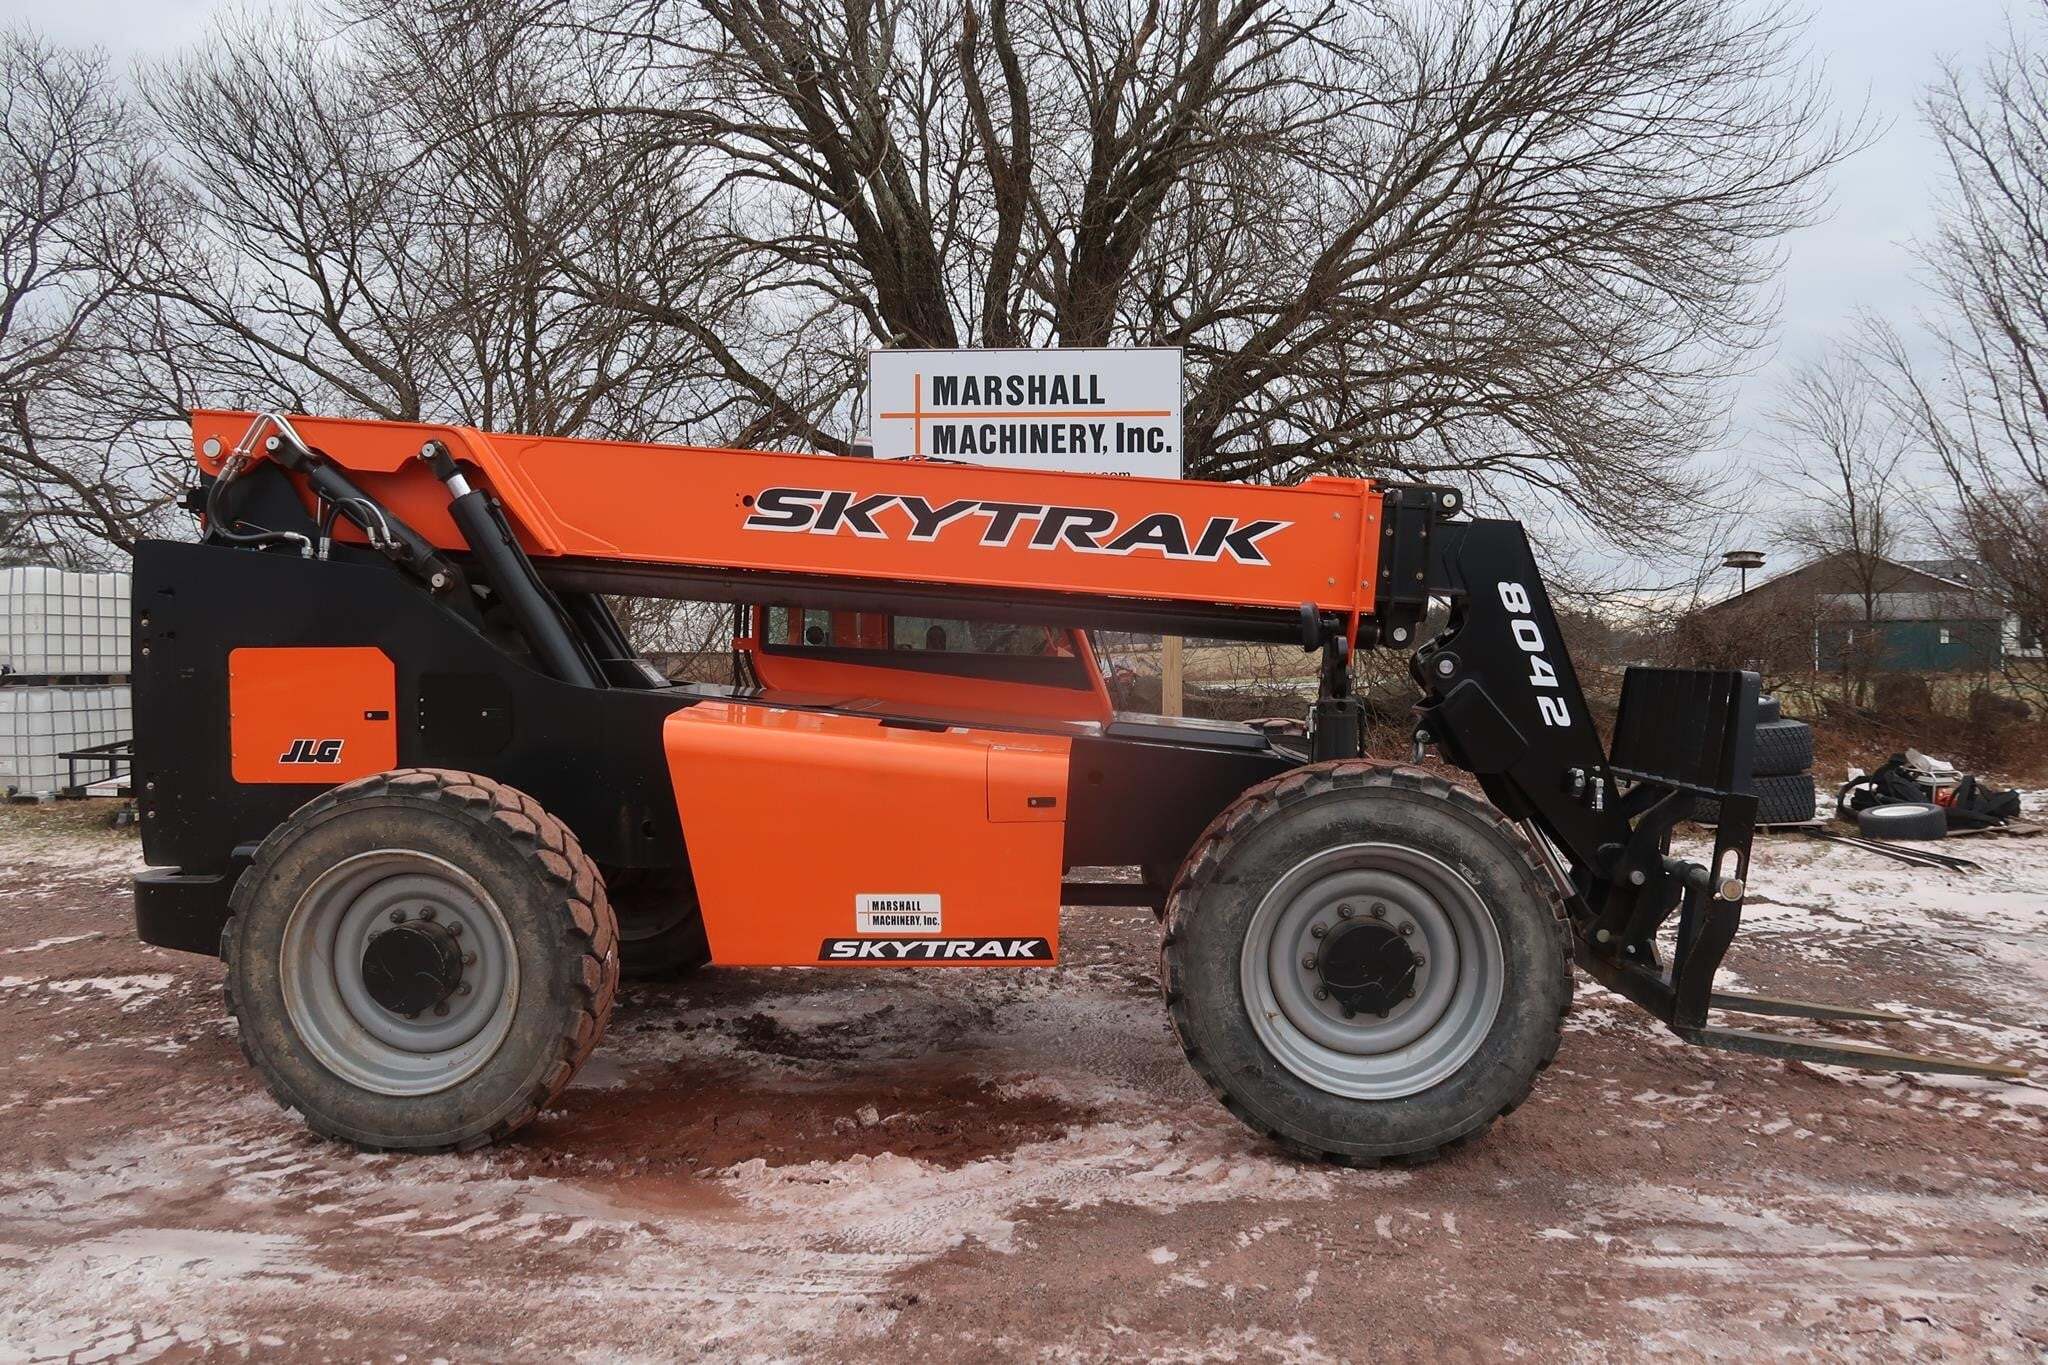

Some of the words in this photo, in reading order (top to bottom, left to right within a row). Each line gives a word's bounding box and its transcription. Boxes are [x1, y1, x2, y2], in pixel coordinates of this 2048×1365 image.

[932, 374, 1106, 406] MARSHALL
[932, 422, 1109, 456] MACHINERY,
[1115, 422, 1173, 453] Inc.
[743, 487, 1295, 567] SKYTRAK
[1497, 581, 1571, 727] 8042
[279, 739, 344, 764] JLG
[871, 900, 921, 912] MARSHALL
[872, 914, 922, 927] MACHINERY,
[923, 915, 940, 926] Inc.
[830, 940, 1040, 958] SKYTRAK
